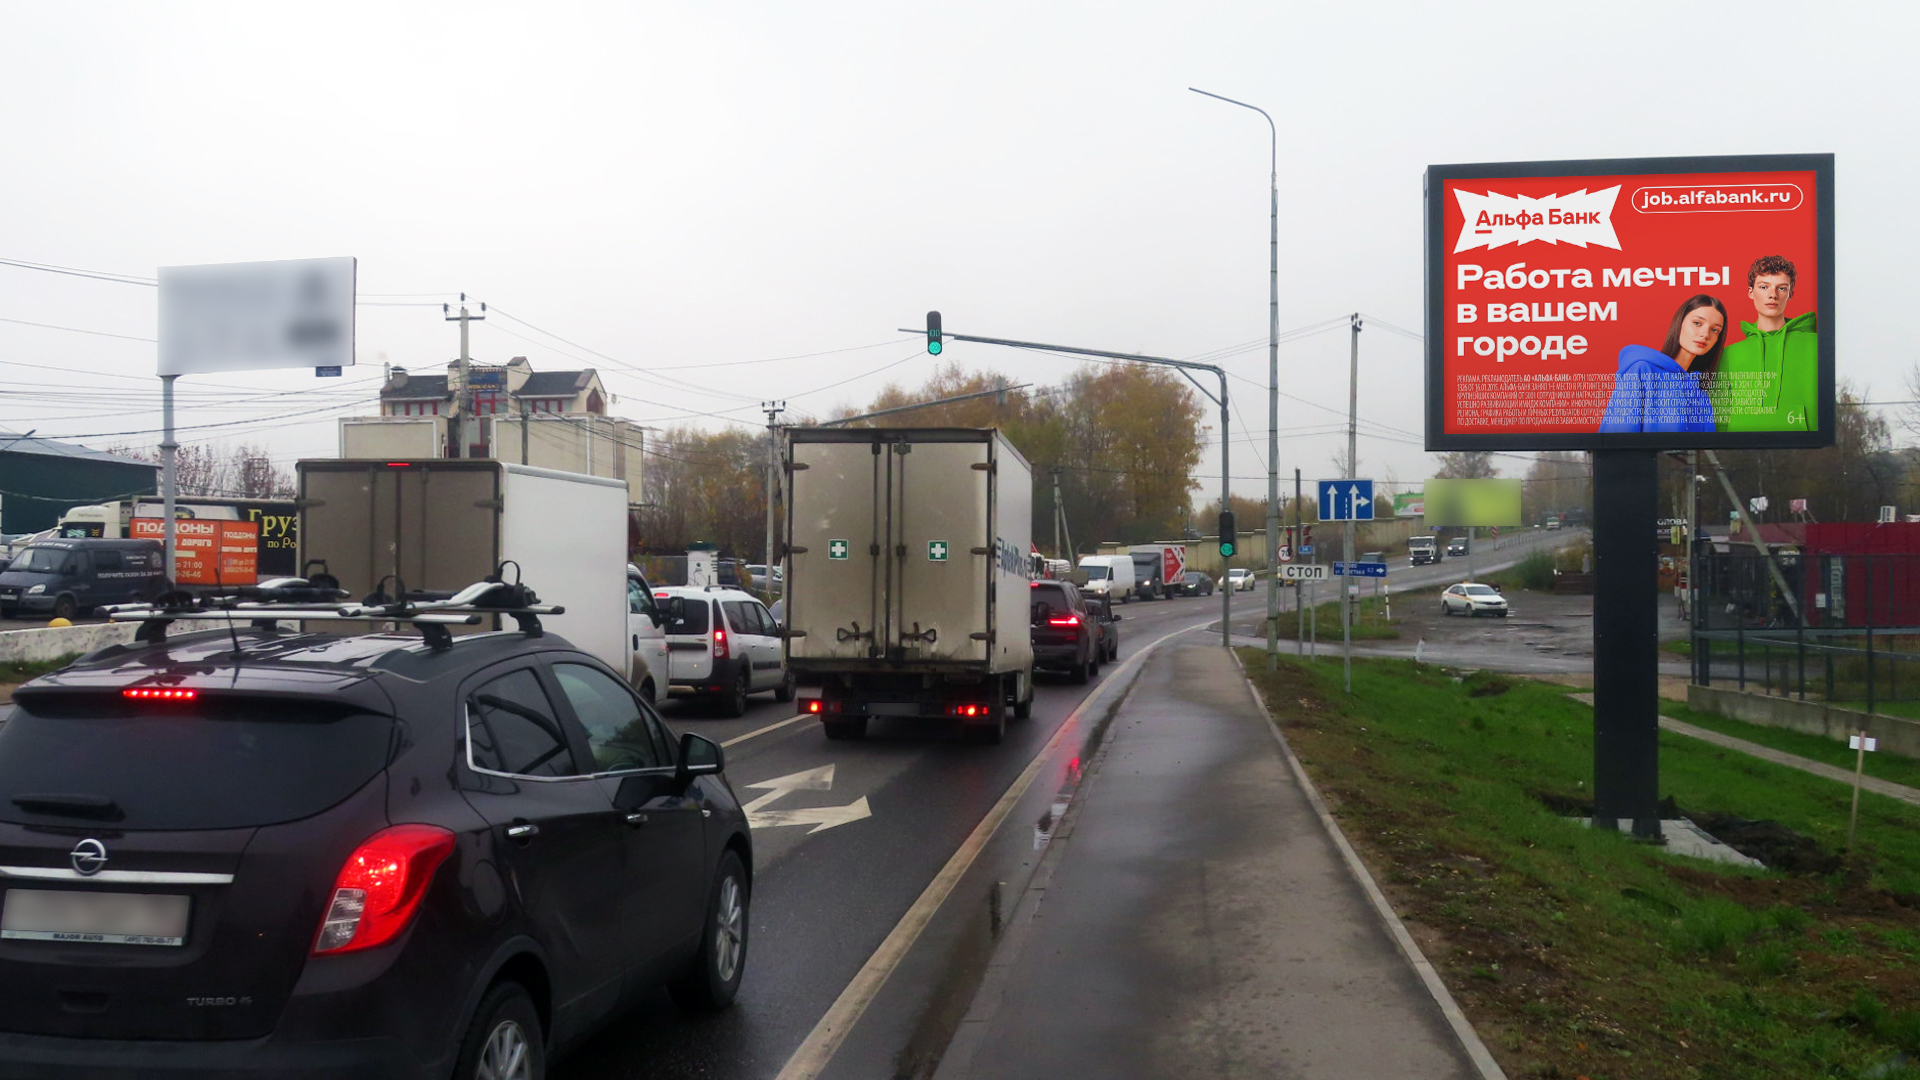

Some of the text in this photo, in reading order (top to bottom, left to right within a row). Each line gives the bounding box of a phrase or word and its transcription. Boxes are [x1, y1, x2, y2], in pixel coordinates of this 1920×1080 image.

[1642, 190, 1791, 209] job.alfabank.ru
[1476, 208, 1600, 230] Альфа Банк
[1457, 262, 1730, 290] Работа мечты
[1457, 302, 1618, 324] в вашем
[1457, 335, 1588, 362] городе
[1787, 411, 1805, 424] 6+
[1287, 566, 1322, 578] СТОП
[186, 997, 236, 1006] TURBO
